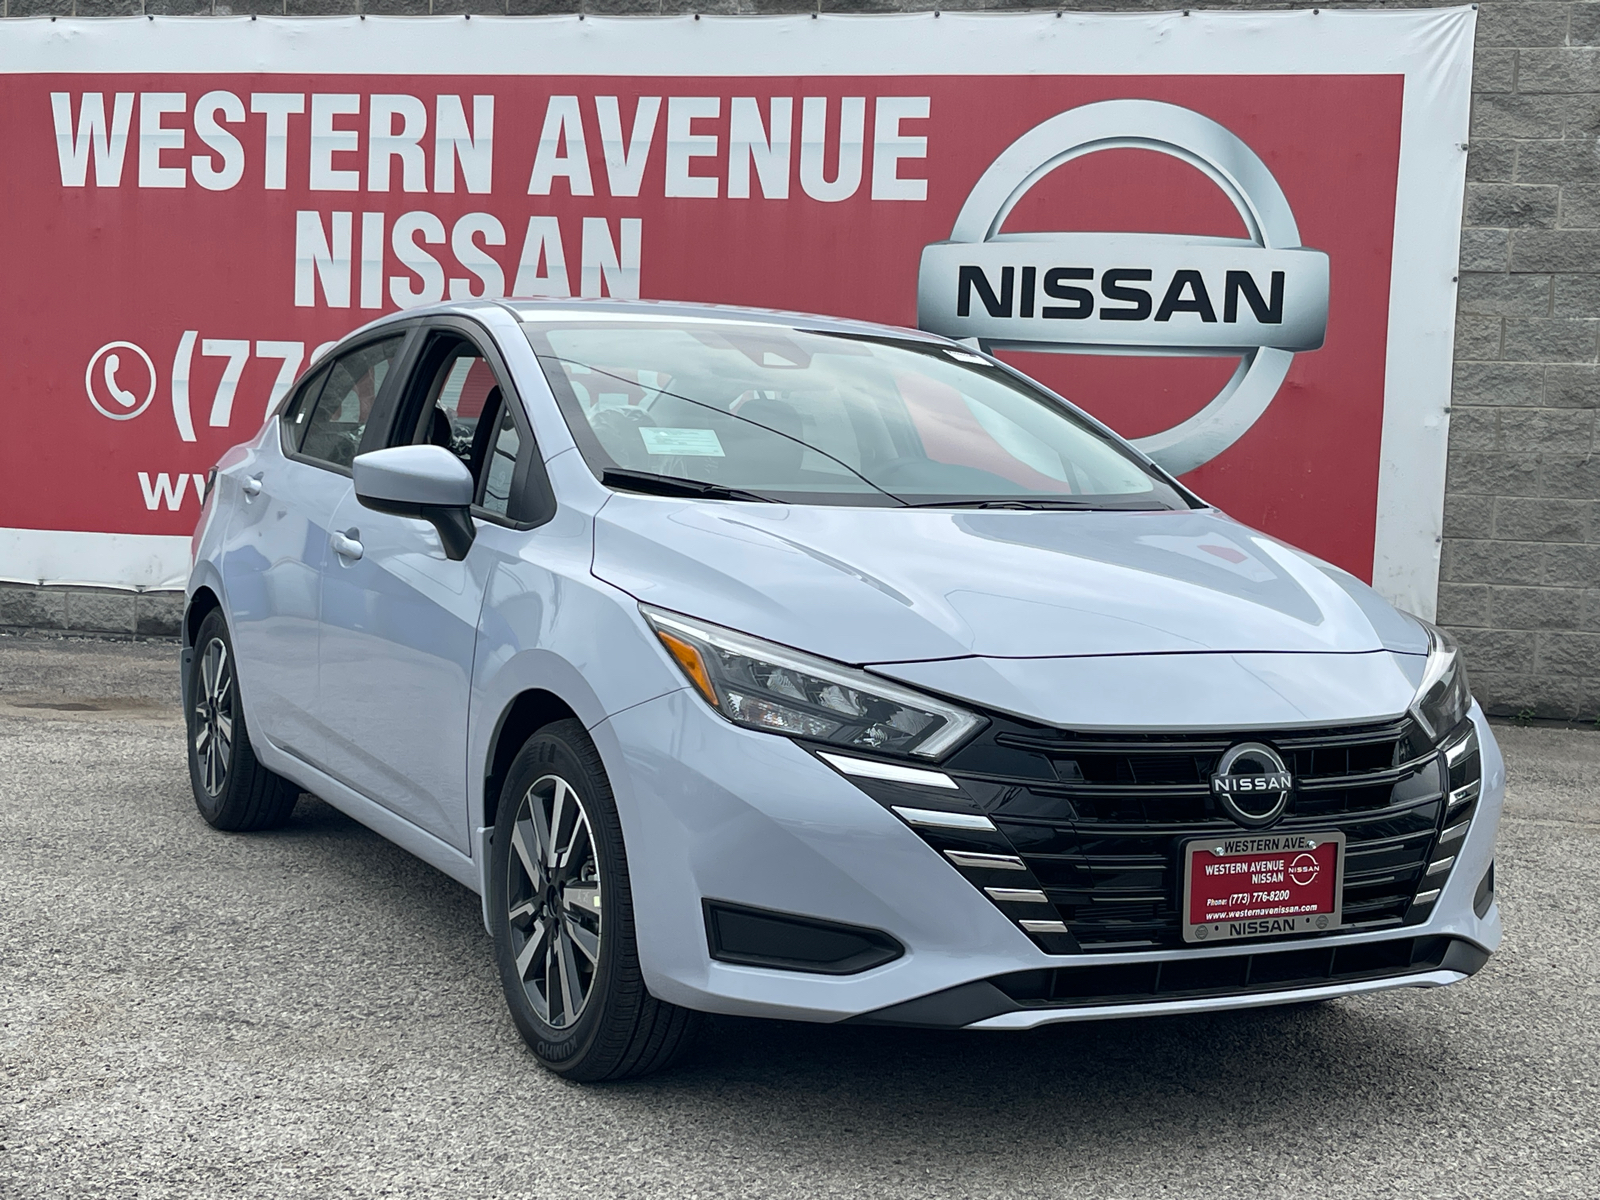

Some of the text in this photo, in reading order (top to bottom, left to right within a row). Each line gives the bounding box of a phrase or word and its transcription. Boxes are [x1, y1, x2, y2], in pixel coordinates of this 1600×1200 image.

[50, 90, 931, 202] WESTERN AVENUE
[294, 210, 642, 311] NISSAN
[956, 266, 1285, 324] NISSAN
[1215, 776, 1292, 791] NISSAN
[1224, 838, 1280, 853] WESTERN
[1205, 860, 1285, 876] WESTERN AVENUE
[1288, 865, 1320, 874] NISSAN
[1252, 872, 1284, 884] NISSAN
[1206, 890, 1290, 907] Phone: (773) 776-8200
[1206, 905, 1317, 920] www.westernavenissan.com
[1230, 919, 1295, 936] NISSAN
